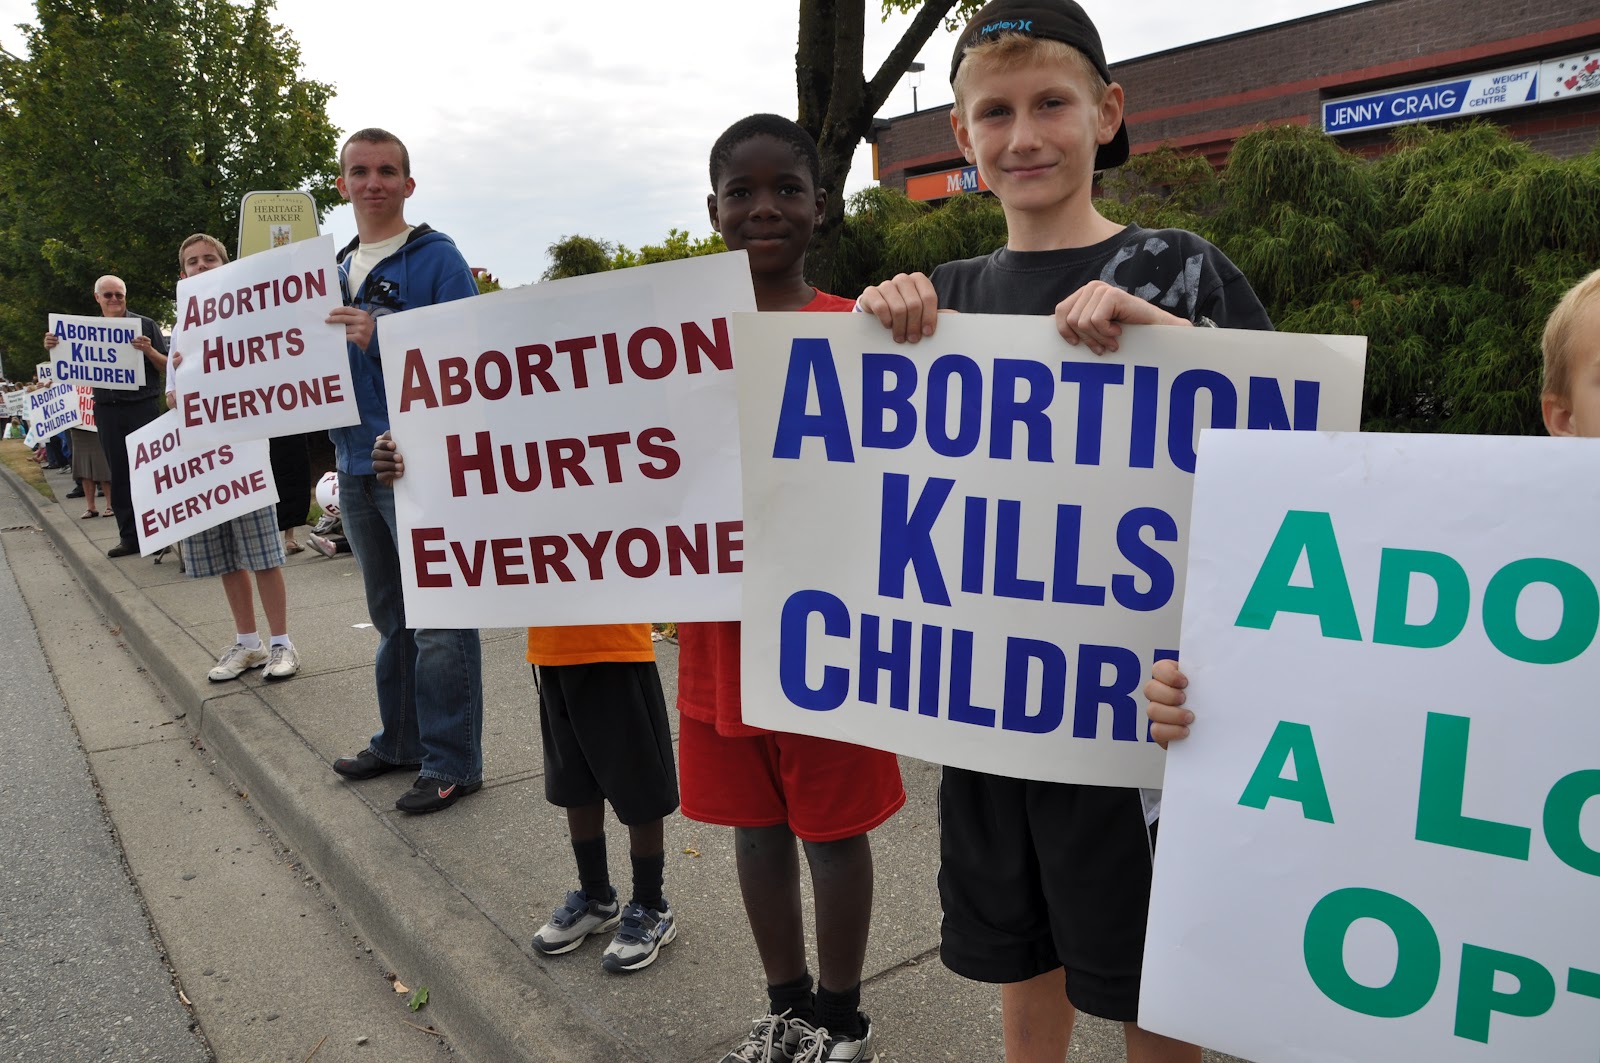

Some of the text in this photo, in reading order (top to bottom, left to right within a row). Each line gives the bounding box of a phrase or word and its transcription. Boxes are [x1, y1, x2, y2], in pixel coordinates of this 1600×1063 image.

[981, 20, 1018, 35] Hurley
[1483, 84, 1507, 96] LOSS
[1491, 70, 1530, 85] WEIGHT
[1330, 89, 1457, 127] JENNY CRAIG
[1469, 94, 1506, 108] CENTRE
[946, 170, 978, 192] M&M
[254, 205, 304, 213] HERITAGE
[258, 214, 301, 222] MARKER
[183, 268, 327, 332] ABORTION
[54, 320, 135, 344] ABORTION
[71, 342, 117, 364] KILLS
[203, 327, 305, 374] HURTS
[399, 317, 734, 413] ABORTION
[56, 360, 135, 384] CHILDREN
[30, 383, 73, 410] ABORTION
[42, 398, 65, 421] KILLS
[183, 374, 345, 428] EVERYONE
[35, 409, 78, 437] CHILDREN
[153, 444, 234, 495] HURTS
[446, 426, 681, 498] HURTS
[141, 469, 267, 538] EVERYONE
[411, 520, 744, 588] EVERYONE
[878, 472, 1179, 612] KILLS
[1234, 509, 1600, 665] ADO
[780, 589, 1180, 743] CHILDR
[1237, 719, 1335, 825] A
